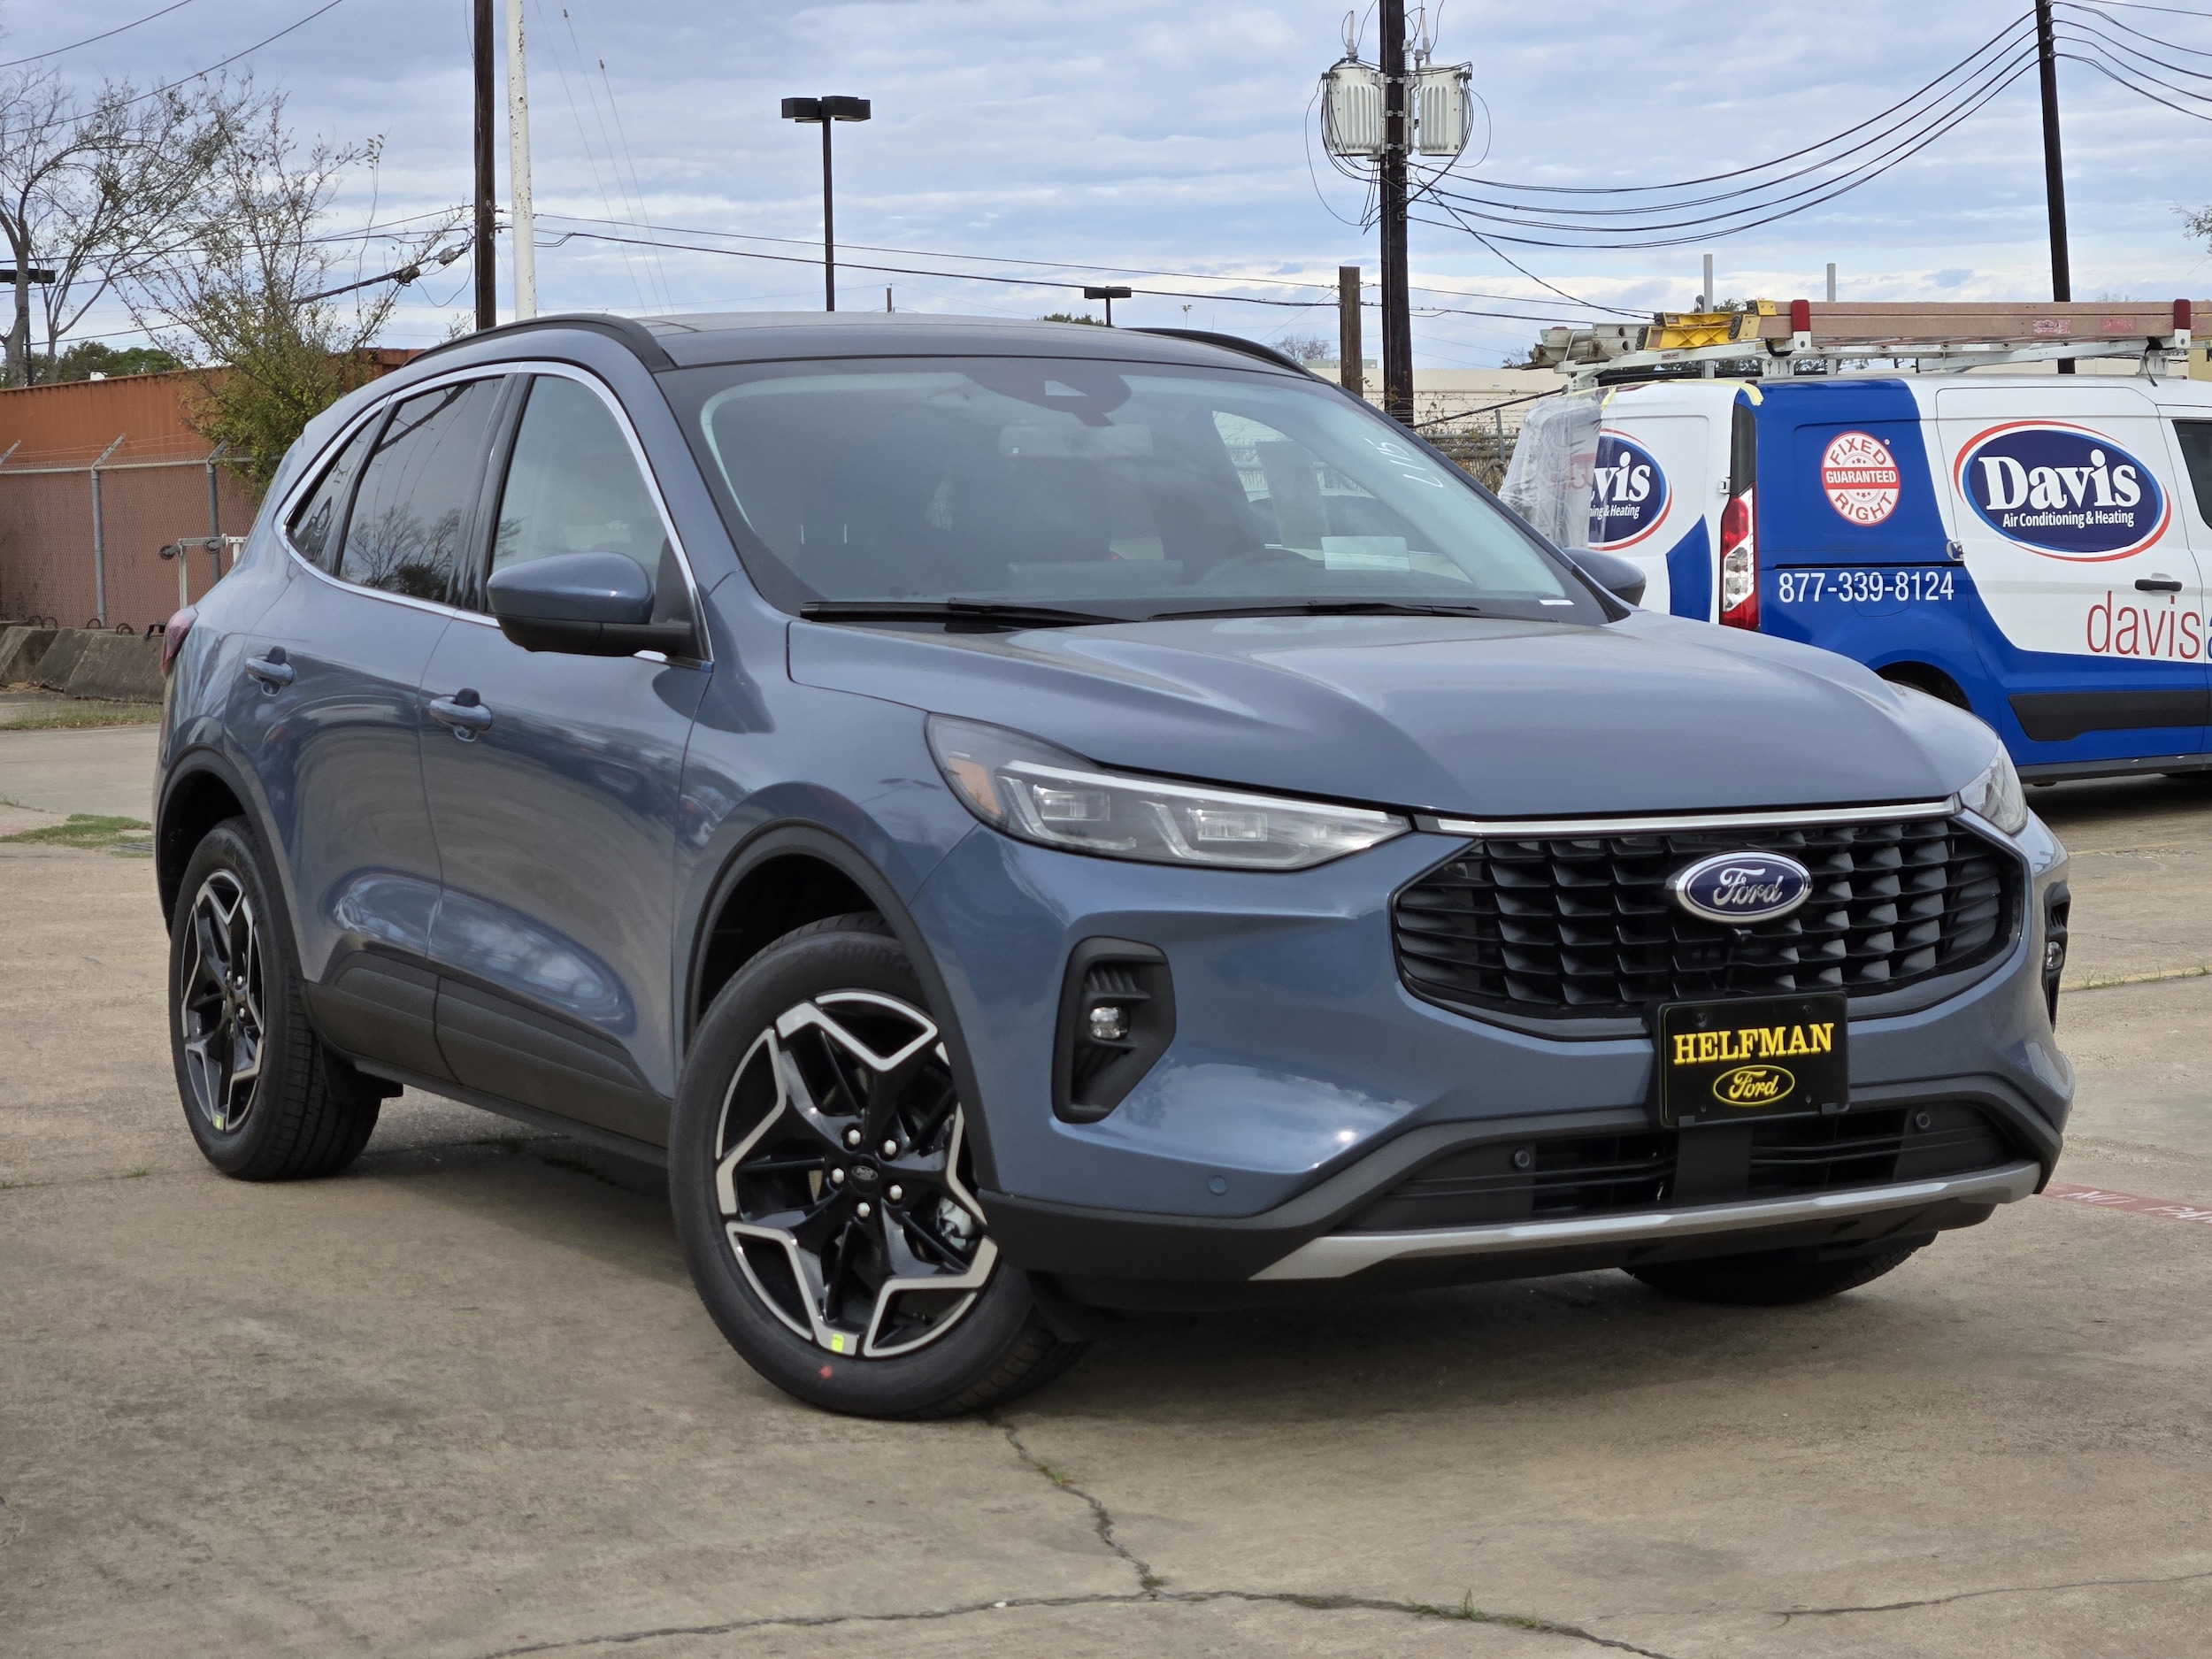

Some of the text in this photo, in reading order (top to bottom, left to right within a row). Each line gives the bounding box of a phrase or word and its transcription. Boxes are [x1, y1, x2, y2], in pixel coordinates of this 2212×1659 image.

[1830, 438, 1887, 465] FIXED
[1591, 451, 1651, 502] vis
[1825, 470, 1897, 484] GUARANTEED
[1978, 449, 2141, 511] Davis
[1610, 503, 1640, 519] Heating
[1834, 491, 1893, 520] RIGHT
[2002, 509, 2135, 528] Air Conditioning & Heating
[1778, 571, 1955, 603] 877-339-8124
[2086, 590, 2212, 660] davis
[1713, 867, 1784, 906] Ford
[1673, 1022, 1835, 1065] HELFMAN
[1728, 1070, 1780, 1100] Ford
